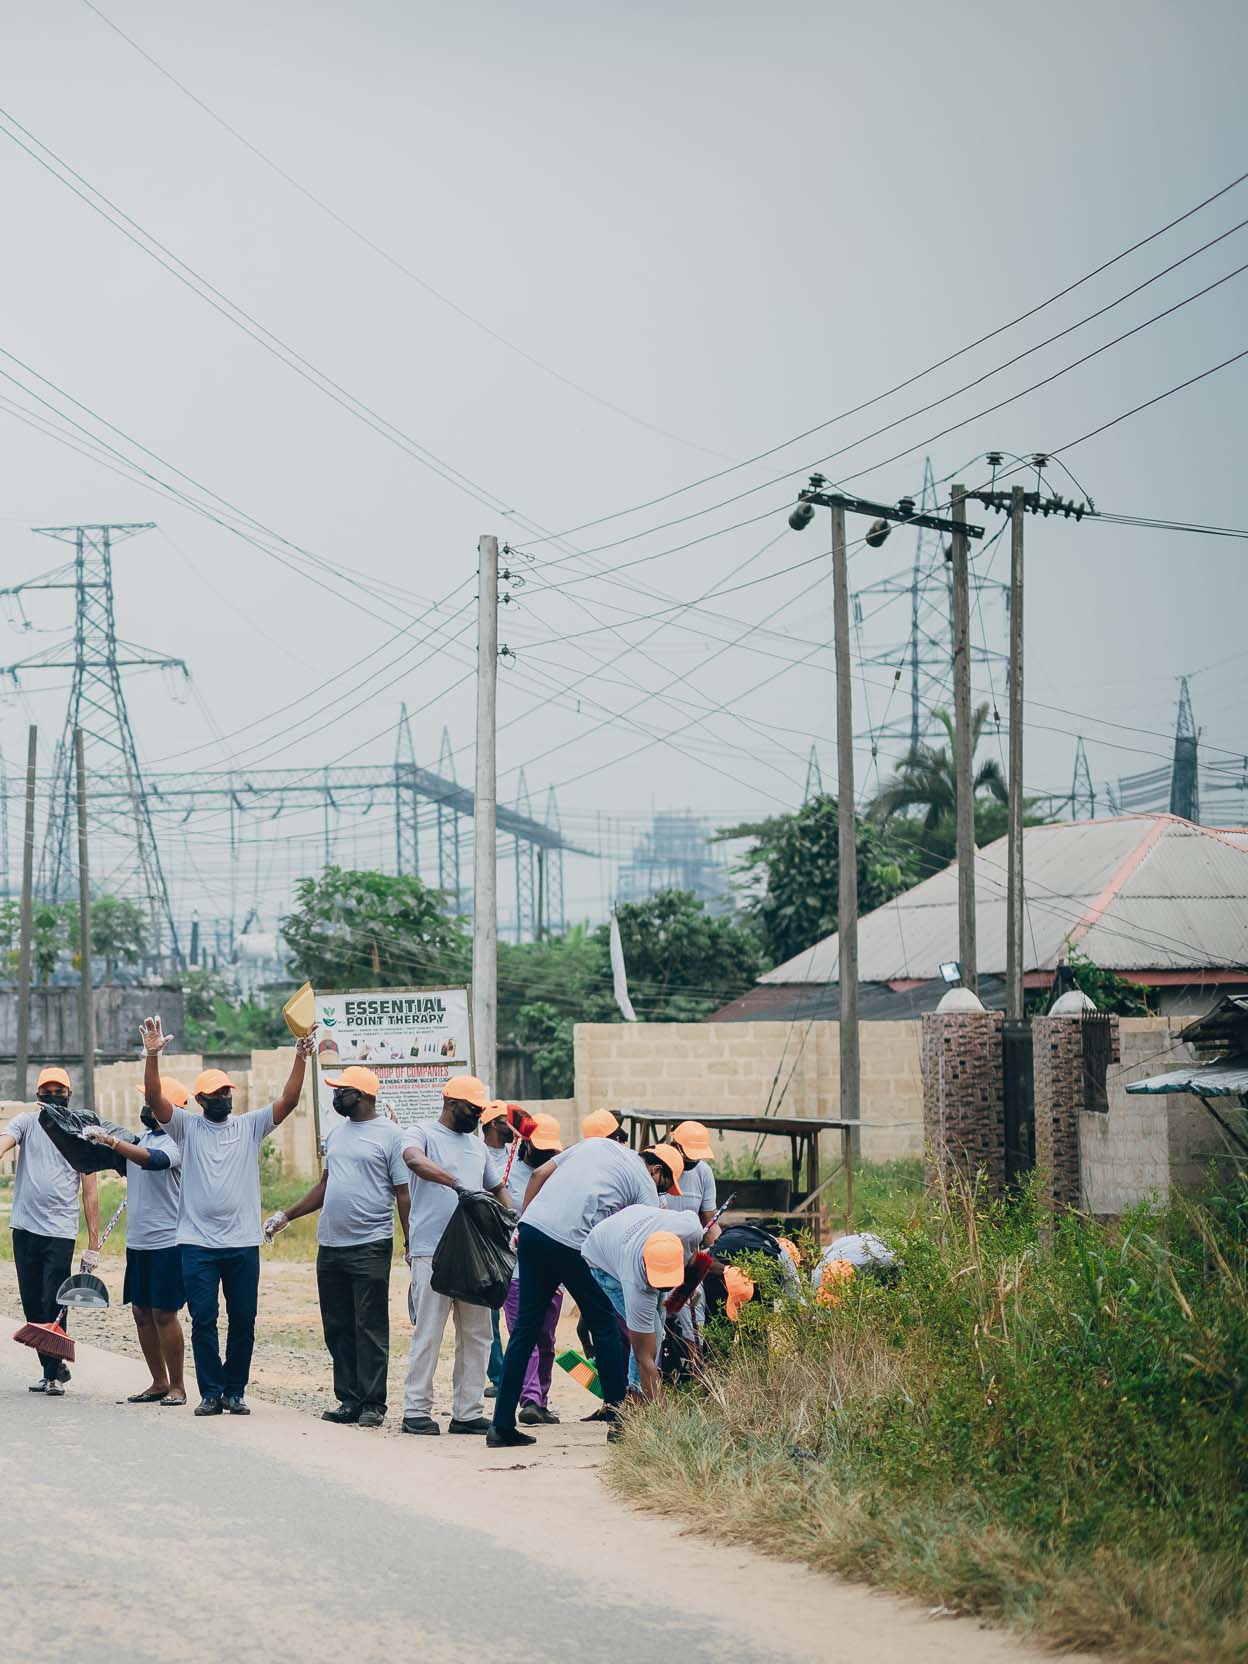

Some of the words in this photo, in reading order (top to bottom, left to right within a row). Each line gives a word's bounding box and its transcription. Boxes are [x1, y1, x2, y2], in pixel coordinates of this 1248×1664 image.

[345, 998, 446, 1015] ESSENTIAL
[347, 1016, 383, 1026] POINT
[388, 1014, 444, 1024] THERAPY
[396, 1065, 405, 1077] OF
[407, 1064, 449, 1077] COMPANIES
